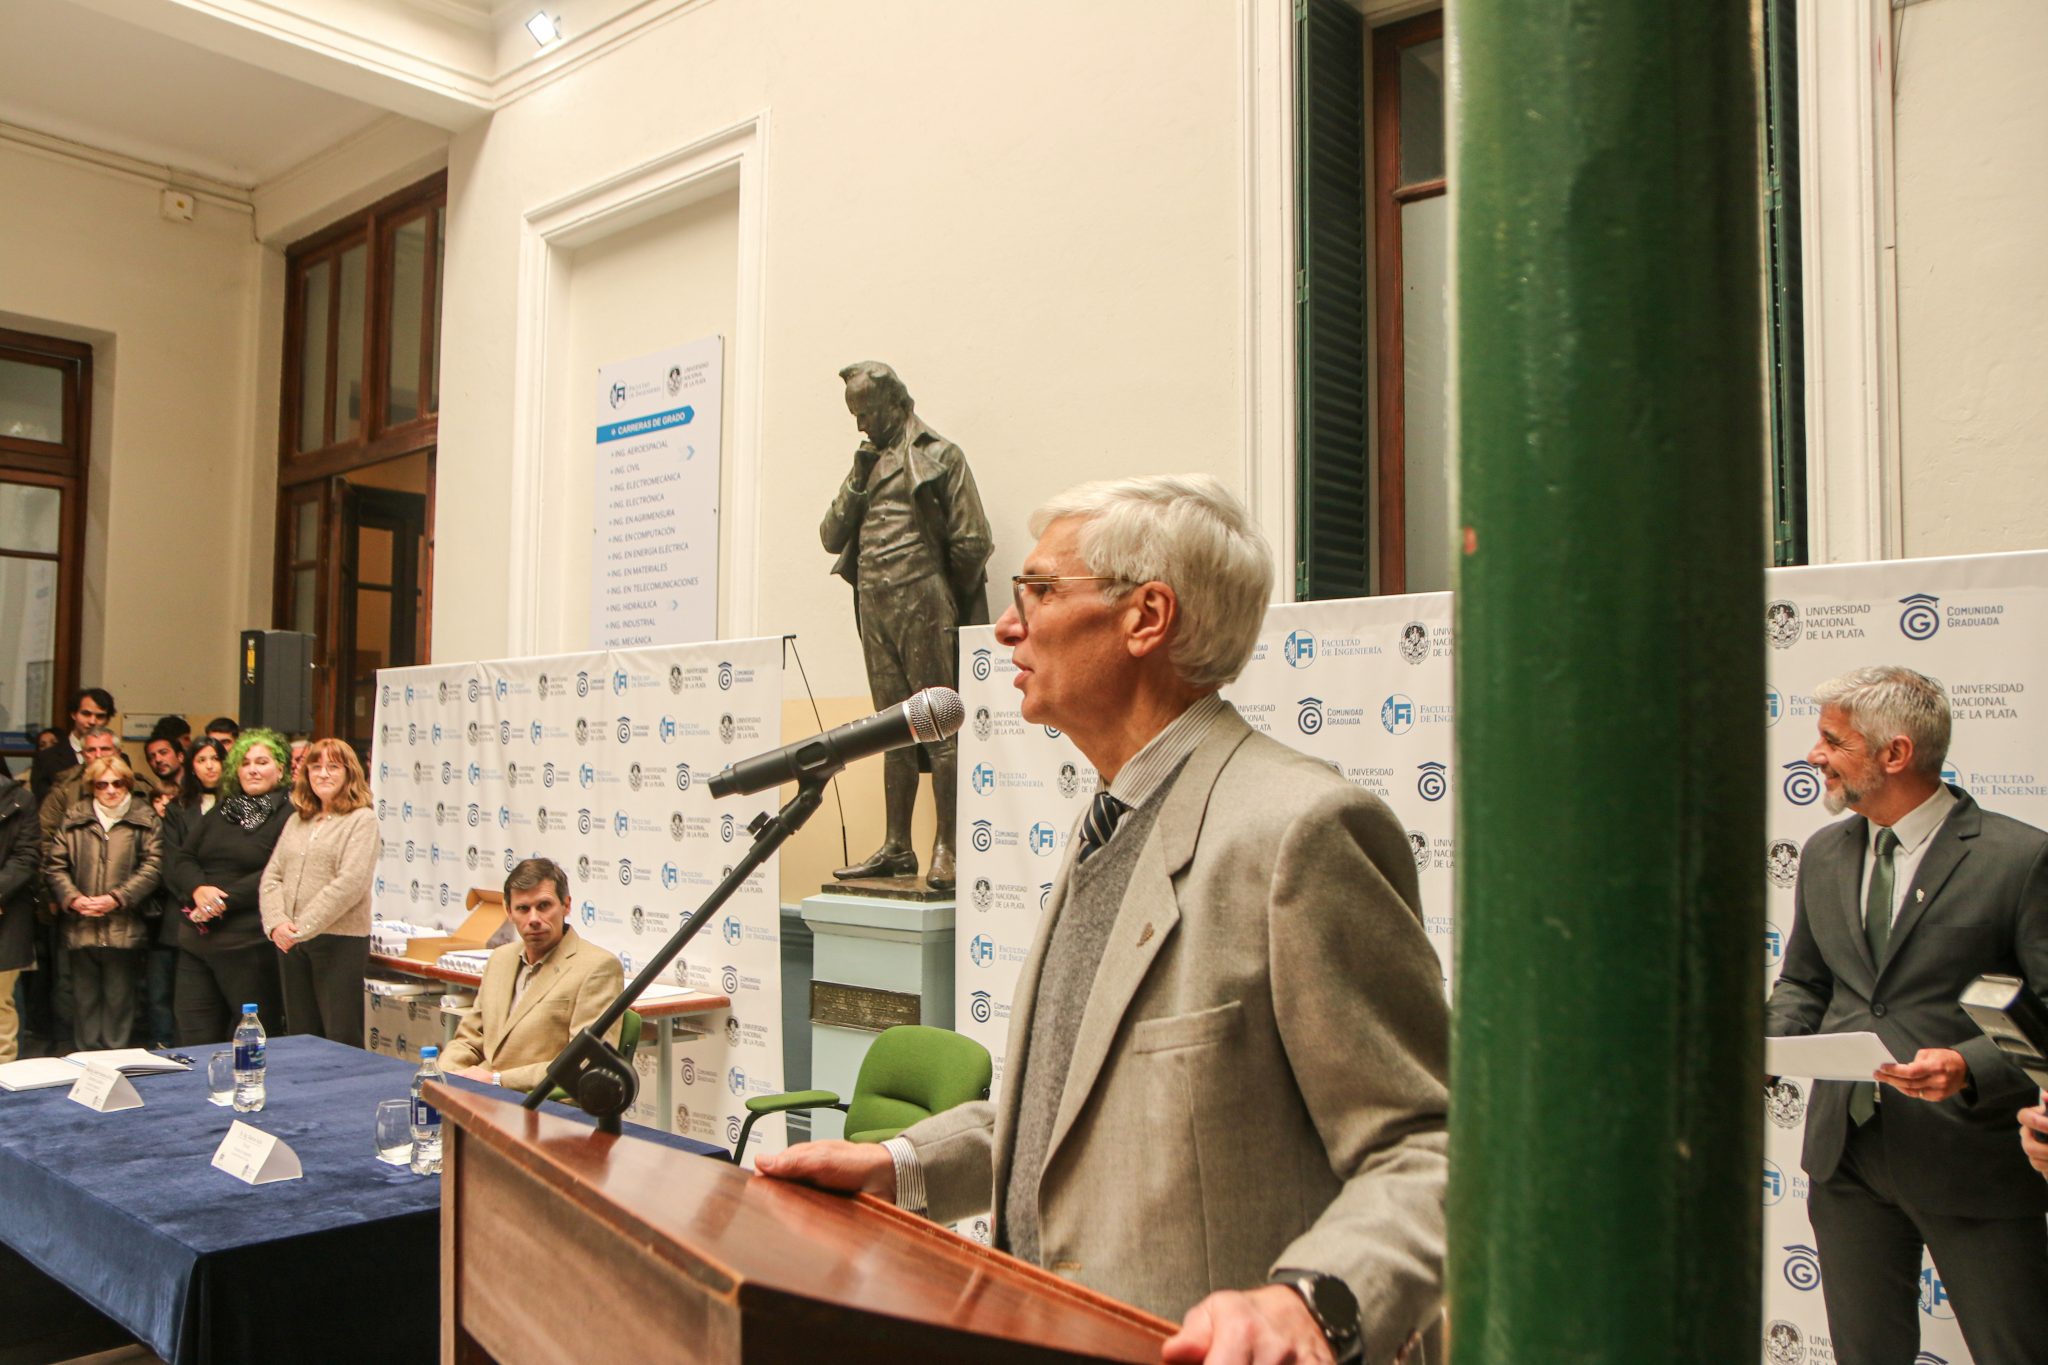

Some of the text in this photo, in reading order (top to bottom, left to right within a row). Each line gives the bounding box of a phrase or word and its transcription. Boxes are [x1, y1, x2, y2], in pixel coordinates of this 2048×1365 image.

[618, 412, 686, 435] CARRERAS DE GRADO
[628, 440, 668, 454] AEROESPACIAL
[627, 463, 640, 472] CIVIL
[626, 515, 633, 523] EN
[634, 509, 675, 522] AGRIMENSURA
[625, 533, 633, 542] EN
[624, 550, 632, 559] EN
[624, 568, 632, 576] EN
[633, 563, 668, 574] MATERIALES
[634, 577, 698, 592] TELECOMUNICACIONES
[1805, 604, 1871, 616] UNIVERSIDAD
[1947, 605, 2004, 617] COMUNIDAD
[623, 618, 656, 627] INDUSTRIAL
[1805, 617, 1856, 628] NACIONAL
[1947, 616, 2000, 627] GRADUADA
[1806, 629, 1865, 640] DE LA PLATA
[1322, 639, 1361, 647] FACULTAD
[1322, 646, 1382, 656] DE INGENIERÍA
[1433, 648, 1442, 656] DE
[1952, 684, 2024, 694] UNIVERSIDAD
[1952, 697, 2007, 707] NACIONAL
[1790, 707, 1805, 716] DE
[1952, 708, 2018, 719] DE LA PLATA
[1244, 714, 1265, 722] CIONAL
[1421, 715, 1431, 723] DE
[1348, 768, 1394, 776] UNIVERSIDAD
[1971, 773, 2035, 784] FACULTAD
[1971, 785, 2048, 795] DE INGENIE
[1434, 860, 1444, 868] DE
